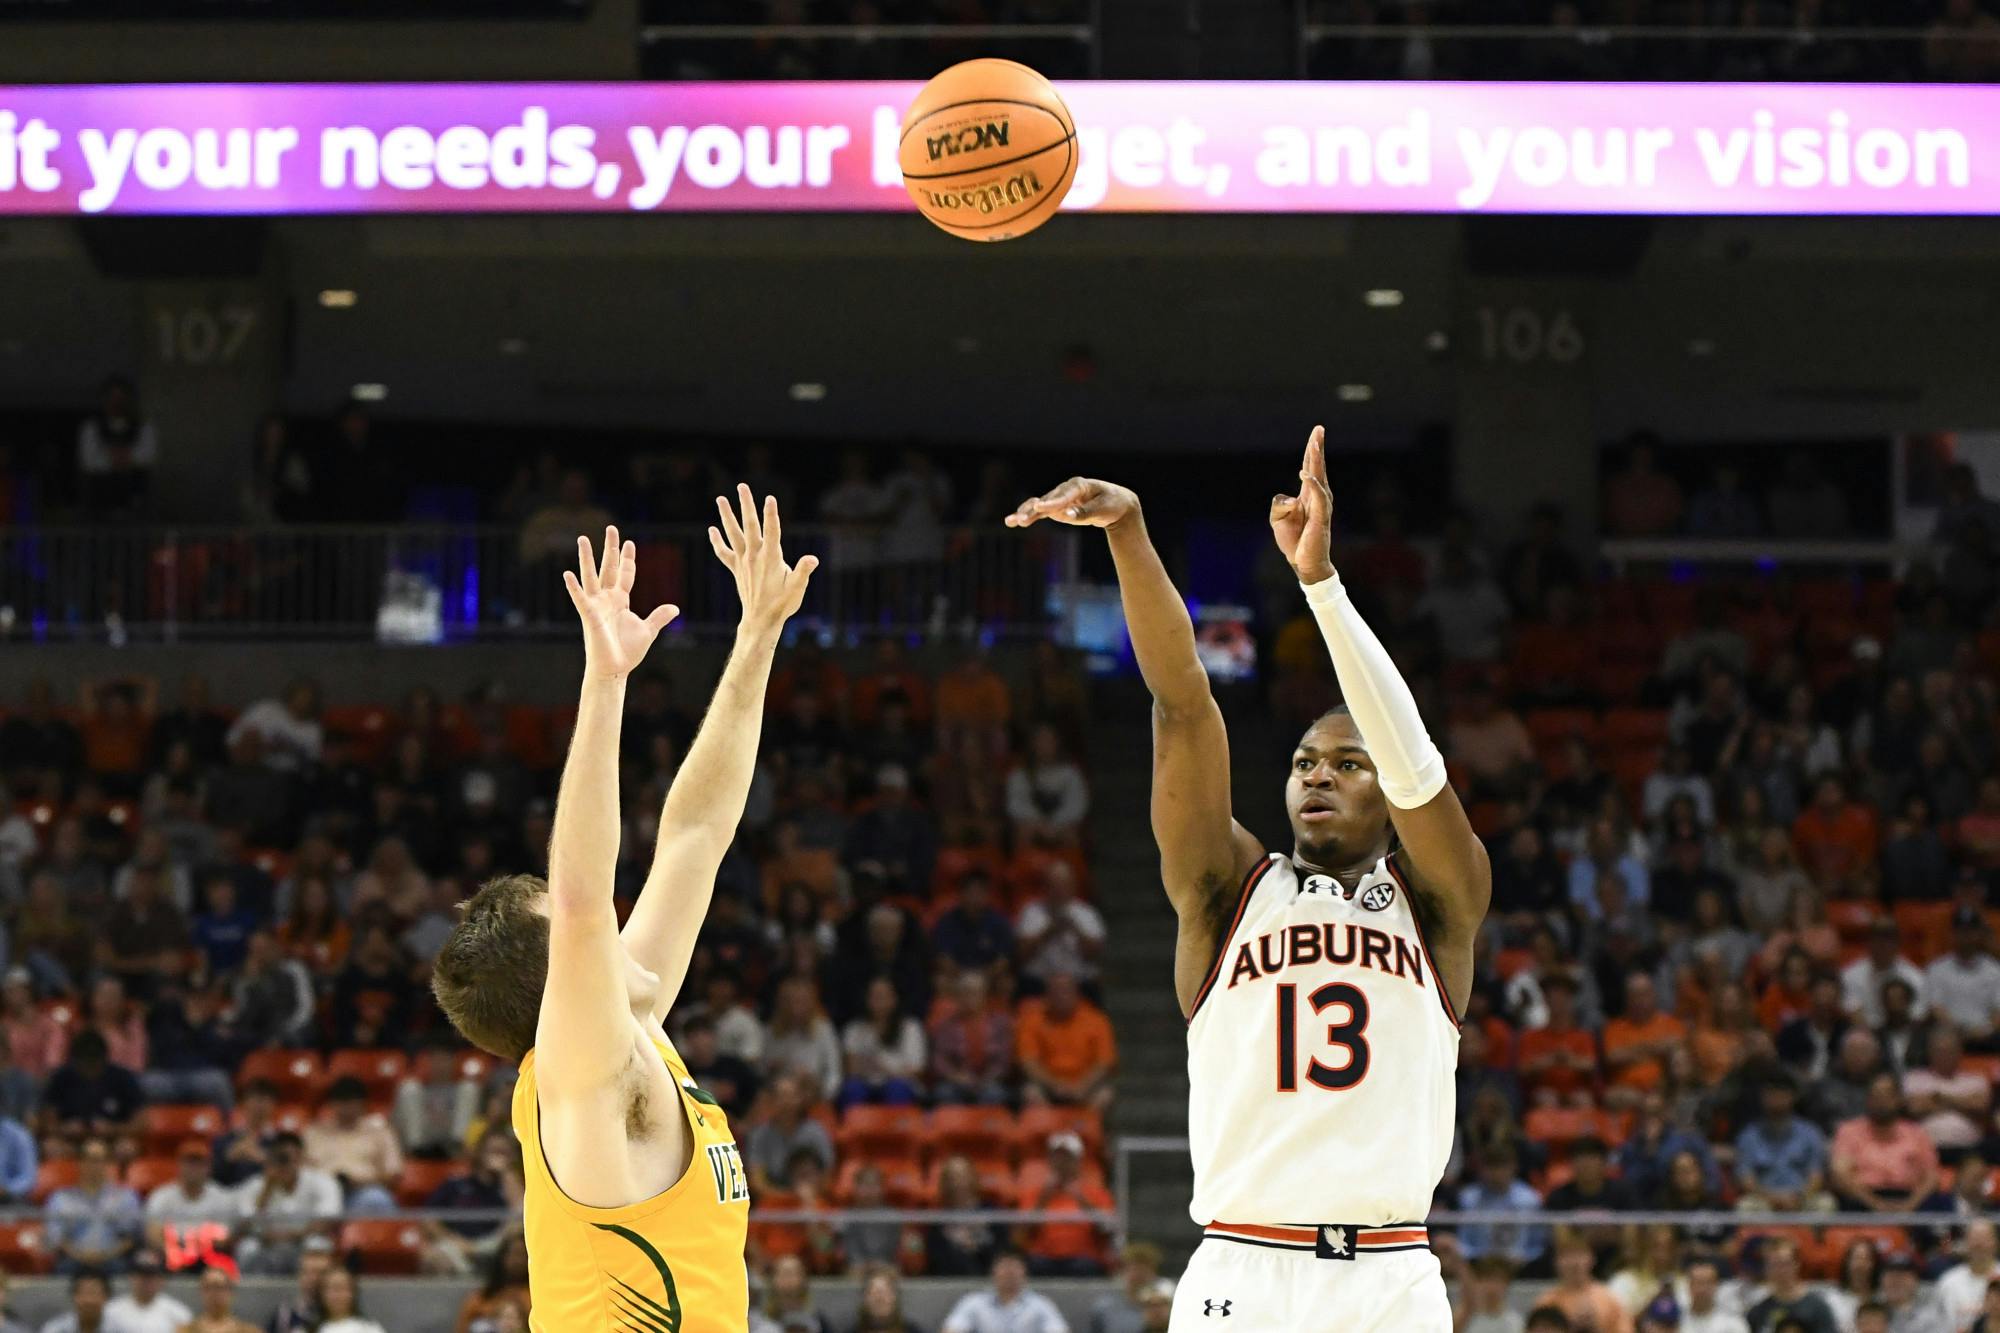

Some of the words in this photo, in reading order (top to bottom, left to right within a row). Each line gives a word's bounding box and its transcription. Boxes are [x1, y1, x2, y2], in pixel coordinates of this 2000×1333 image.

[0, 109, 60, 192] it
[78, 125, 298, 213] your
[320, 106, 622, 199] needs,
[627, 123, 849, 210] your
[872, 105, 1231, 209] bget,
[1254, 107, 1431, 189] and
[1456, 124, 1674, 210] your
[1697, 109, 1970, 189] vision
[926, 120, 1009, 162] NCAA
[921, 169, 1044, 214] Wilson
[152, 304, 256, 362] 107
[1476, 305, 1584, 362] 106
[1363, 884, 1393, 910] SEC
[1228, 923, 1425, 990] AUBURN
[1276, 982, 1371, 1092] 13
